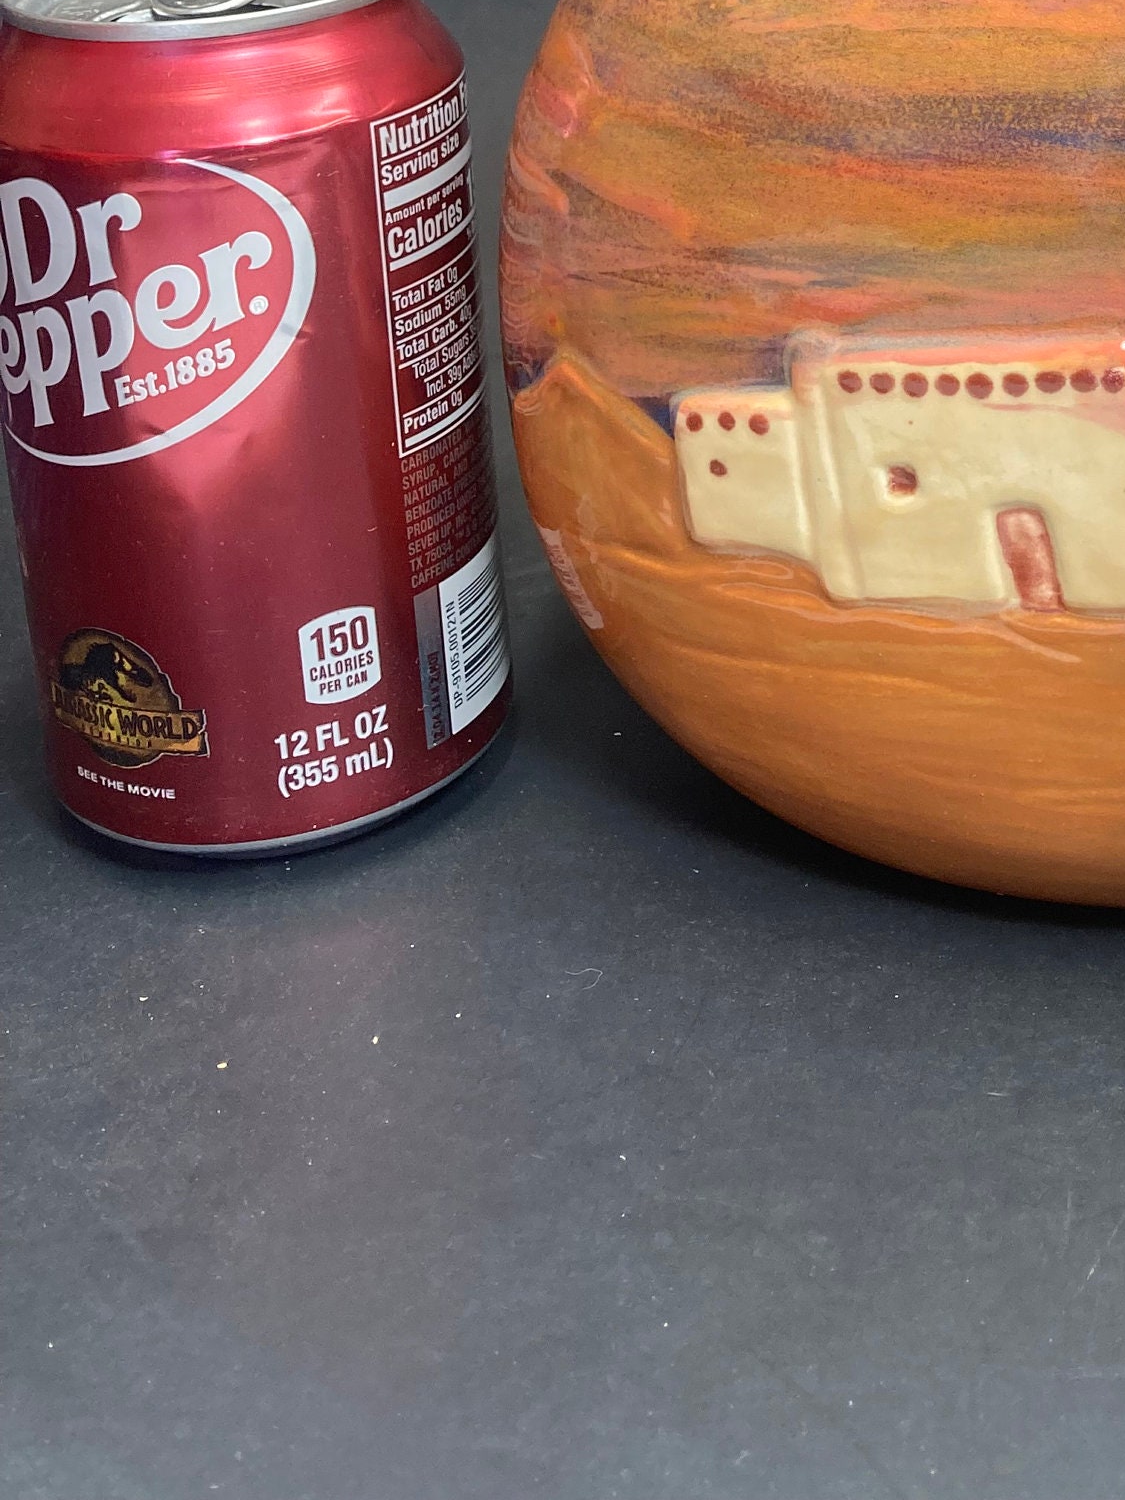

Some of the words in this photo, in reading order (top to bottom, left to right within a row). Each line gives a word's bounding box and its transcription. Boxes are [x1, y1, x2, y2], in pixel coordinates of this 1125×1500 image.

[379, 94, 460, 158] Nutrition
[381, 149, 439, 186] Serving
[441, 131, 460, 158] size
[385, 196, 425, 225] Amount
[426, 190, 440, 210] per
[442, 173, 464, 197] serving
[0, 177, 142, 306] Dr
[387, 198, 463, 259] Calories
[392, 284, 425, 311] Total
[427, 274, 445, 299] Fat
[447, 266, 458, 284] 0g
[395, 303, 443, 336] Sodium
[444, 284, 467, 312] 55mg
[0, 231, 272, 427] epper
[396, 333, 429, 360] Total
[432, 316, 458, 344] Carb.
[412, 352, 440, 379] Total
[441, 333, 470, 363] Sugars
[426, 375, 446, 398] Incl.
[447, 365, 462, 385] 39g
[462, 348, 480, 373] Add
[403, 401, 449, 434] Protein
[451, 389, 463, 405] 0g
[400, 431, 463, 473] CARBONATED
[402, 463, 440, 490] SYRUP,
[403, 473, 449, 507] NATURAL
[405, 489, 453, 524] BENZOATE
[406, 502, 456, 540] PRODUCED
[408, 531, 440, 556] SEVEN
[410, 558, 423, 573] TX
[411, 555, 455, 589] CAFFEINE
[310, 615, 369, 662] 150
[310, 650, 374, 682] CALORIES
[319, 678, 341, 696] PER
[346, 670, 368, 688] CAN
[117, 708, 198, 740] WORLD
[274, 729, 310, 760] 12
[316, 720, 350, 752] FL
[354, 704, 389, 740] OZ
[77, 765, 98, 784] SEE
[99, 775, 125, 792] THE
[127, 783, 176, 799] MOVIE
[277, 755, 340, 798] (355
[345, 737, 394, 777] mL)
